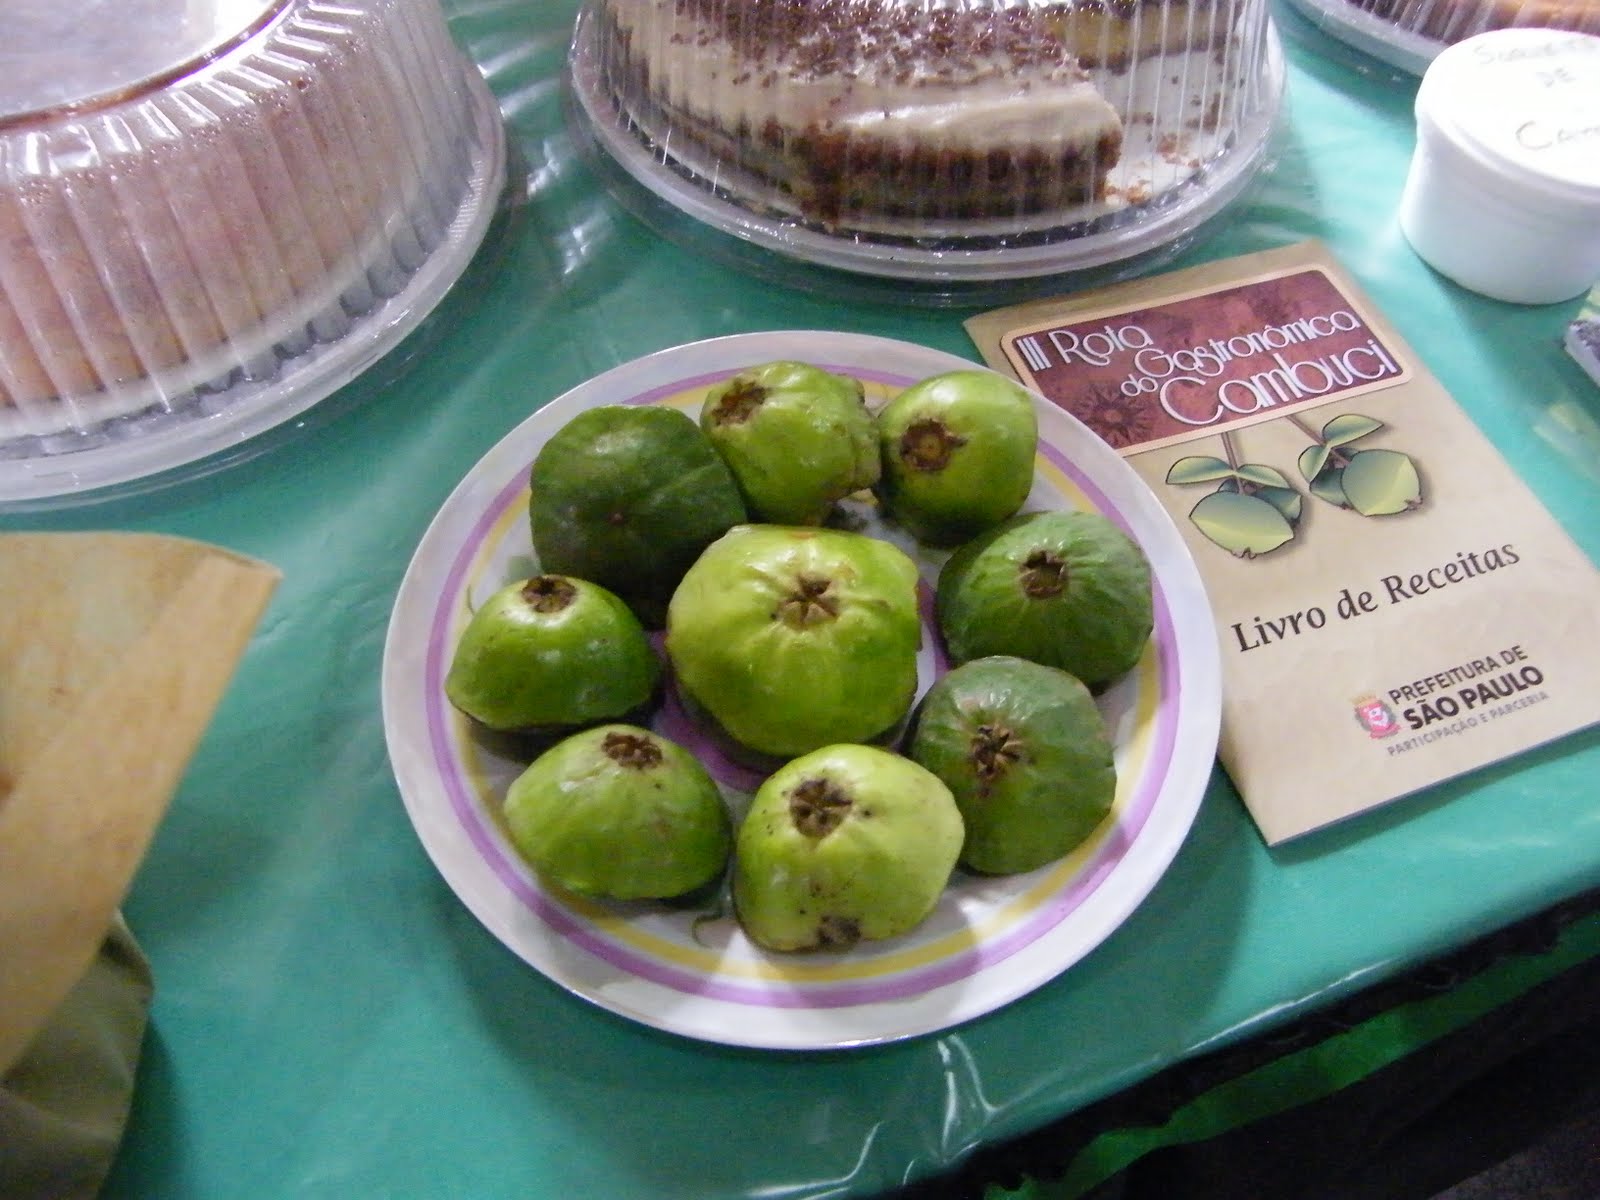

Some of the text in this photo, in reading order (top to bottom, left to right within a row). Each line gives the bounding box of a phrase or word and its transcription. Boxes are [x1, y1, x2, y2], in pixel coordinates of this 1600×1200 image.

[1016, 325, 1154, 372] III Rota
[1134, 311, 1361, 377] Gastronômica
[1120, 339, 1397, 425] do Cambuci
[1231, 543, 1521, 652] Livro de Receitas
[1388, 645, 1528, 705] PREFEITURA DE
[1403, 665, 1544, 730] SÃO PAULO
[1387, 690, 1550, 757] PARTICIPAÇÃO E PARCERIA
